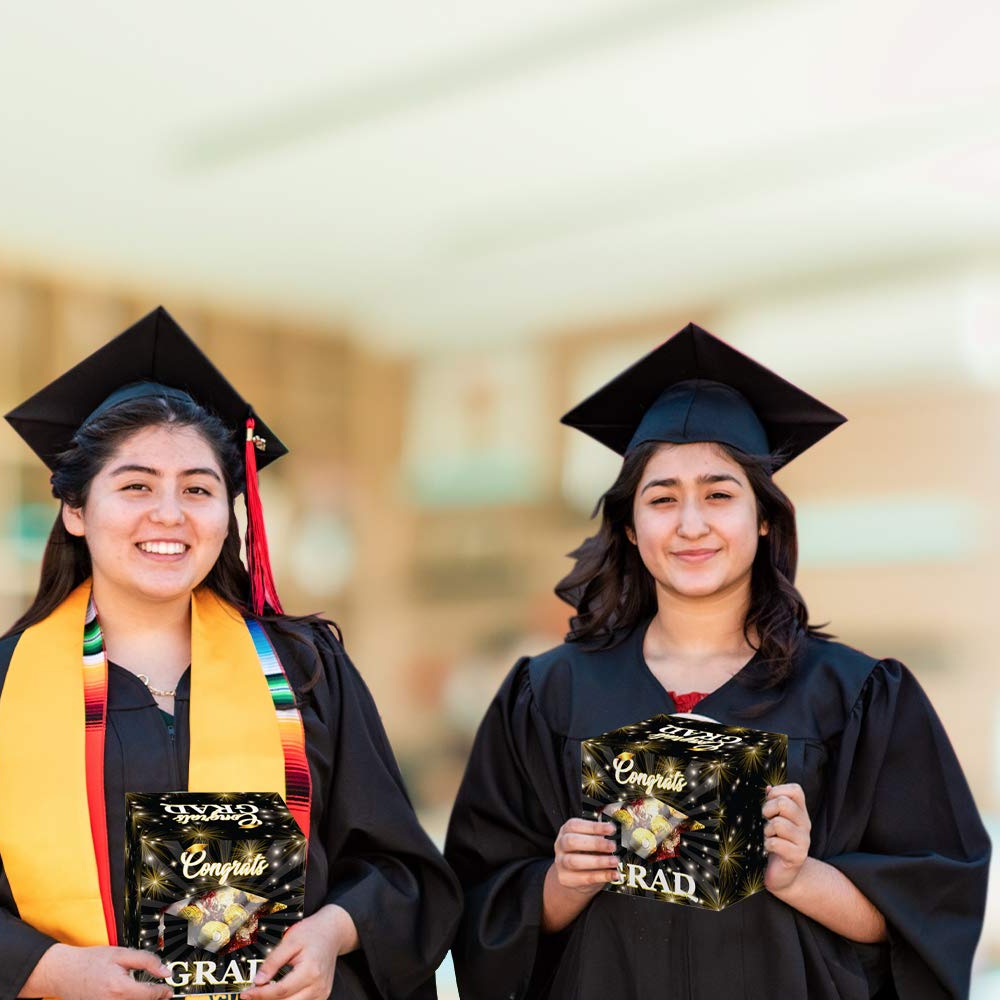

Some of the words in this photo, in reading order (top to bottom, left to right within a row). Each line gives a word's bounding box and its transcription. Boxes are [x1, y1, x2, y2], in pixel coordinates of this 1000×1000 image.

[612, 757, 687, 795] Congrats
[160, 803, 259, 815] GRAD
[173, 812, 263, 828] Congrats
[180, 850, 269, 885] Congrats
